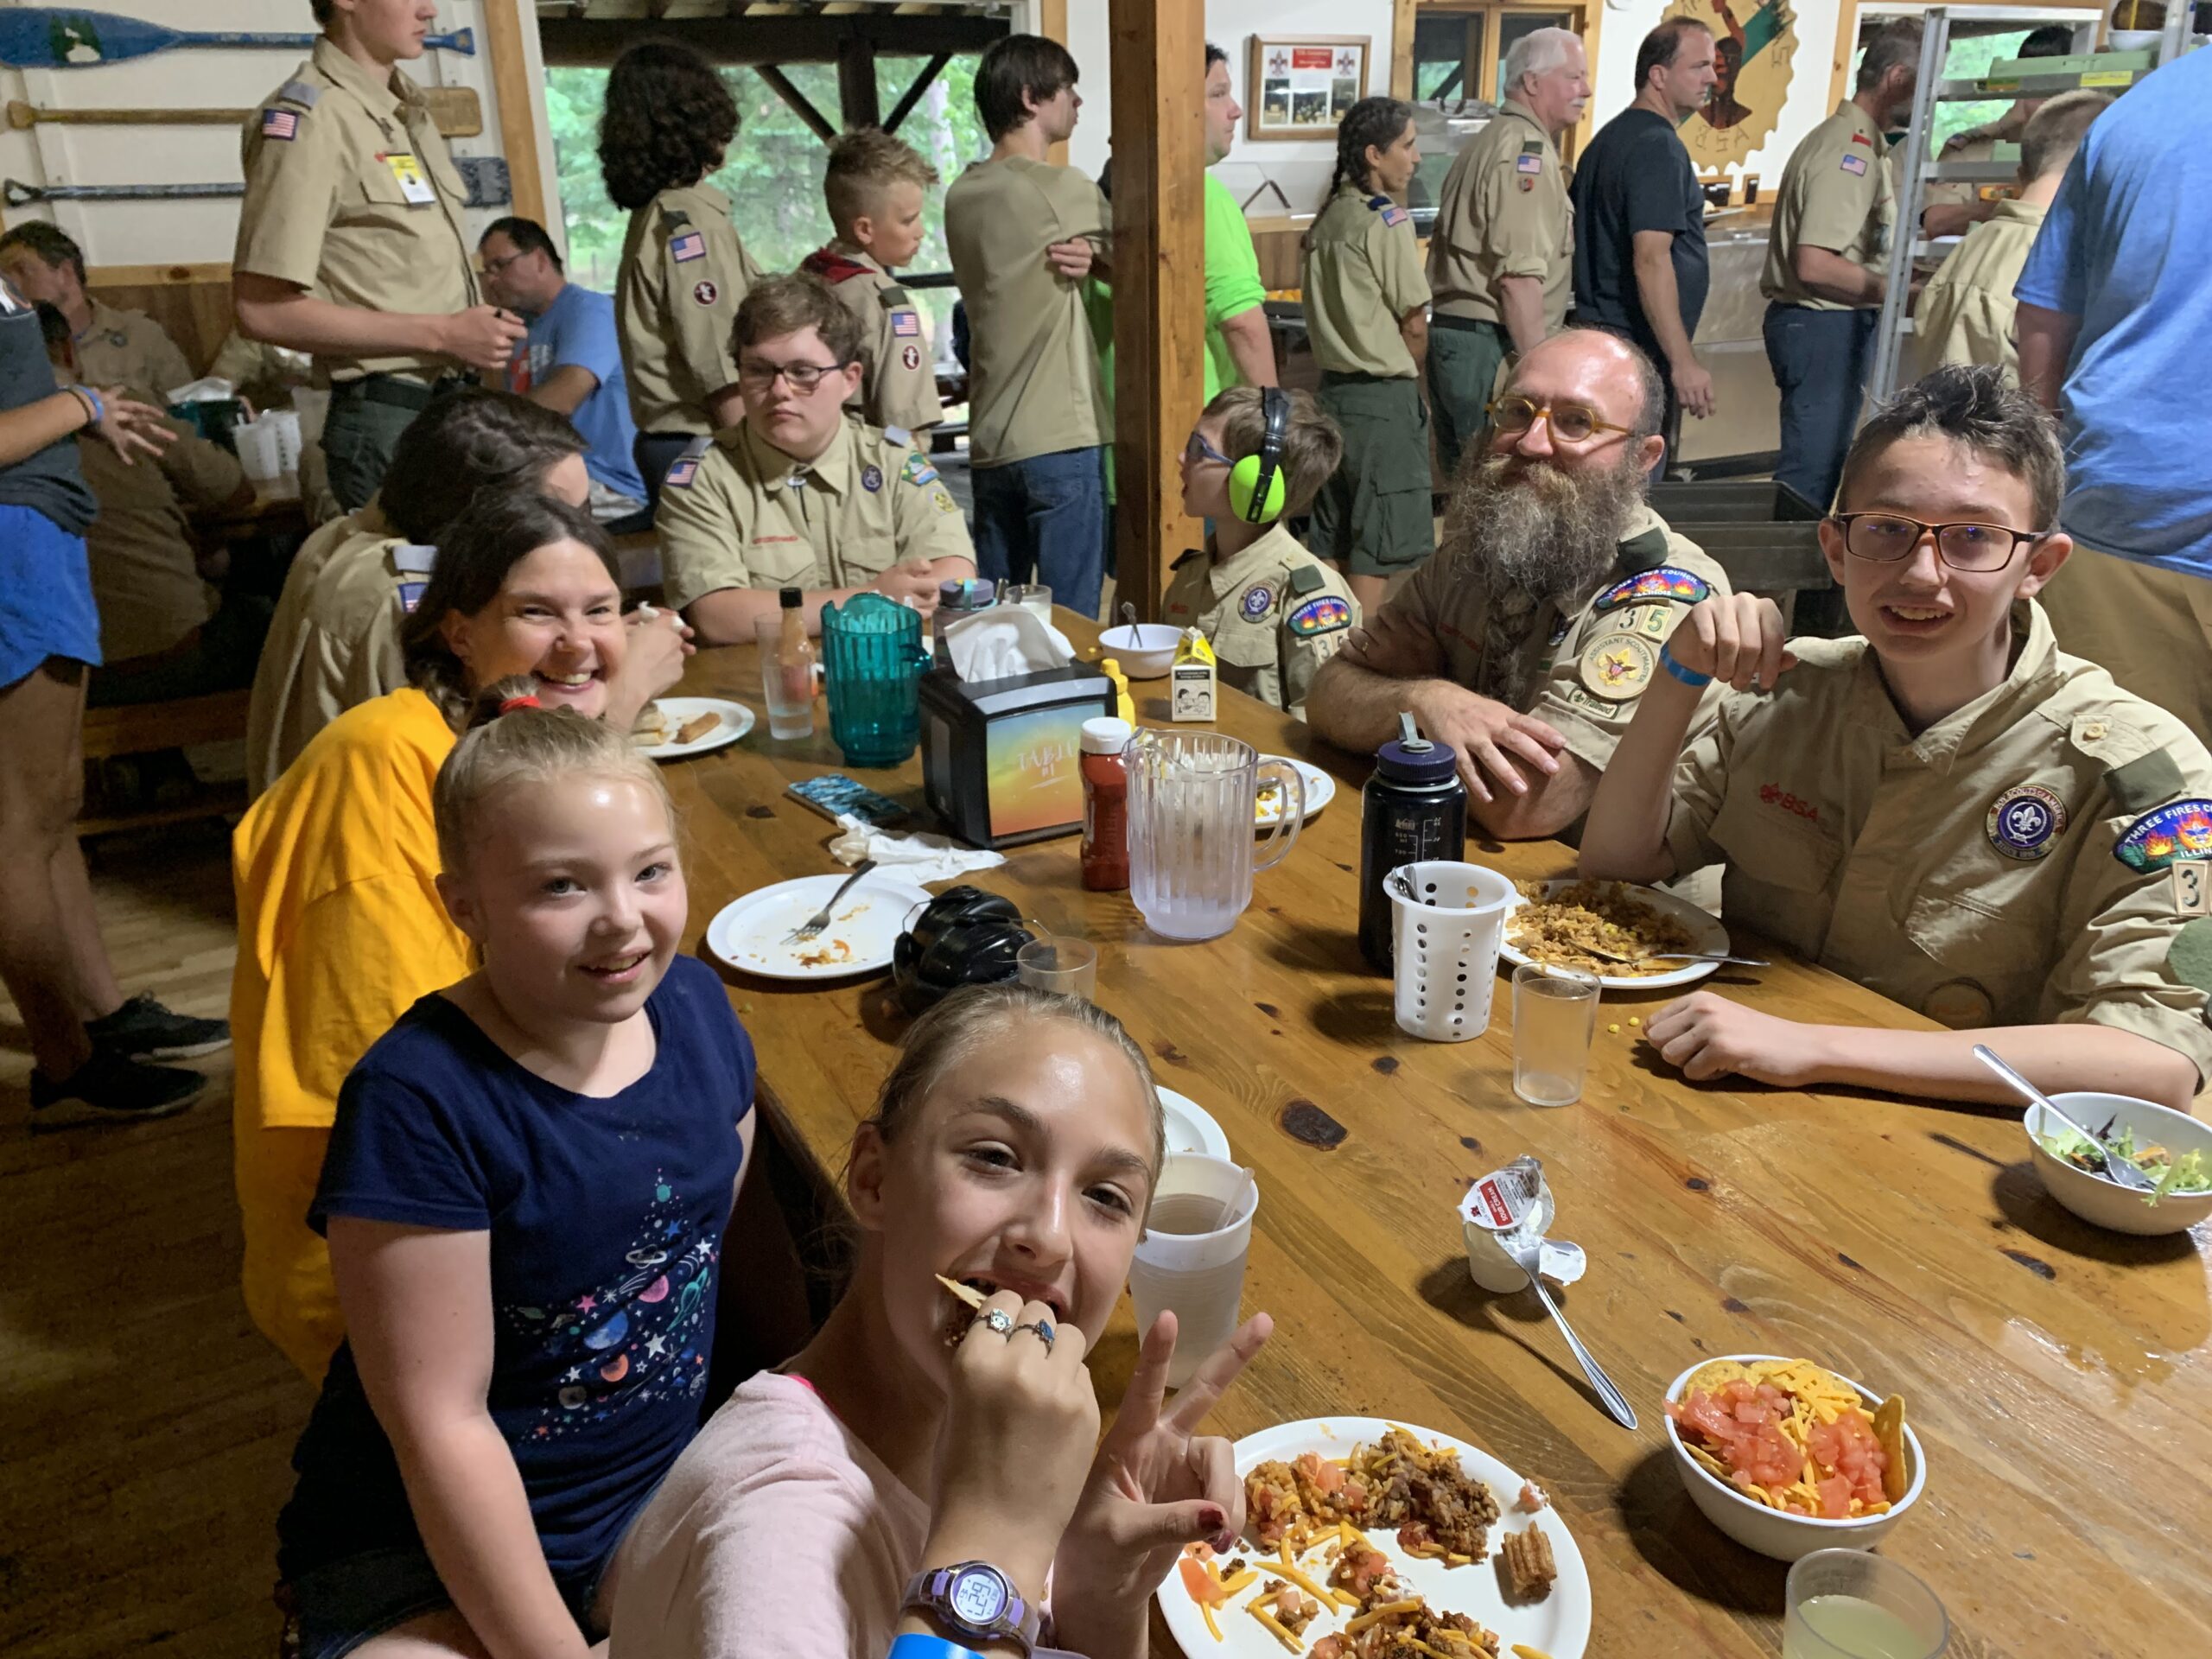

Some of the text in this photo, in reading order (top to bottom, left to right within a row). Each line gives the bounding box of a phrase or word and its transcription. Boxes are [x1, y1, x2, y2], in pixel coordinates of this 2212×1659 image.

[1661, 569, 1700, 586] COUNCIL
[1618, 607, 1668, 633] 35
[1589, 636, 1651, 684] ASSISTANT SCOUTMASTER
[1584, 696, 1615, 715] Trained
[1780, 792, 1819, 823] BSA
[2124, 815, 2164, 845] THREE
[2164, 803, 2202, 821] FIRES
[2181, 868, 2201, 908] 3
[1487, 1185, 1509, 1222] SOUR CREAM
